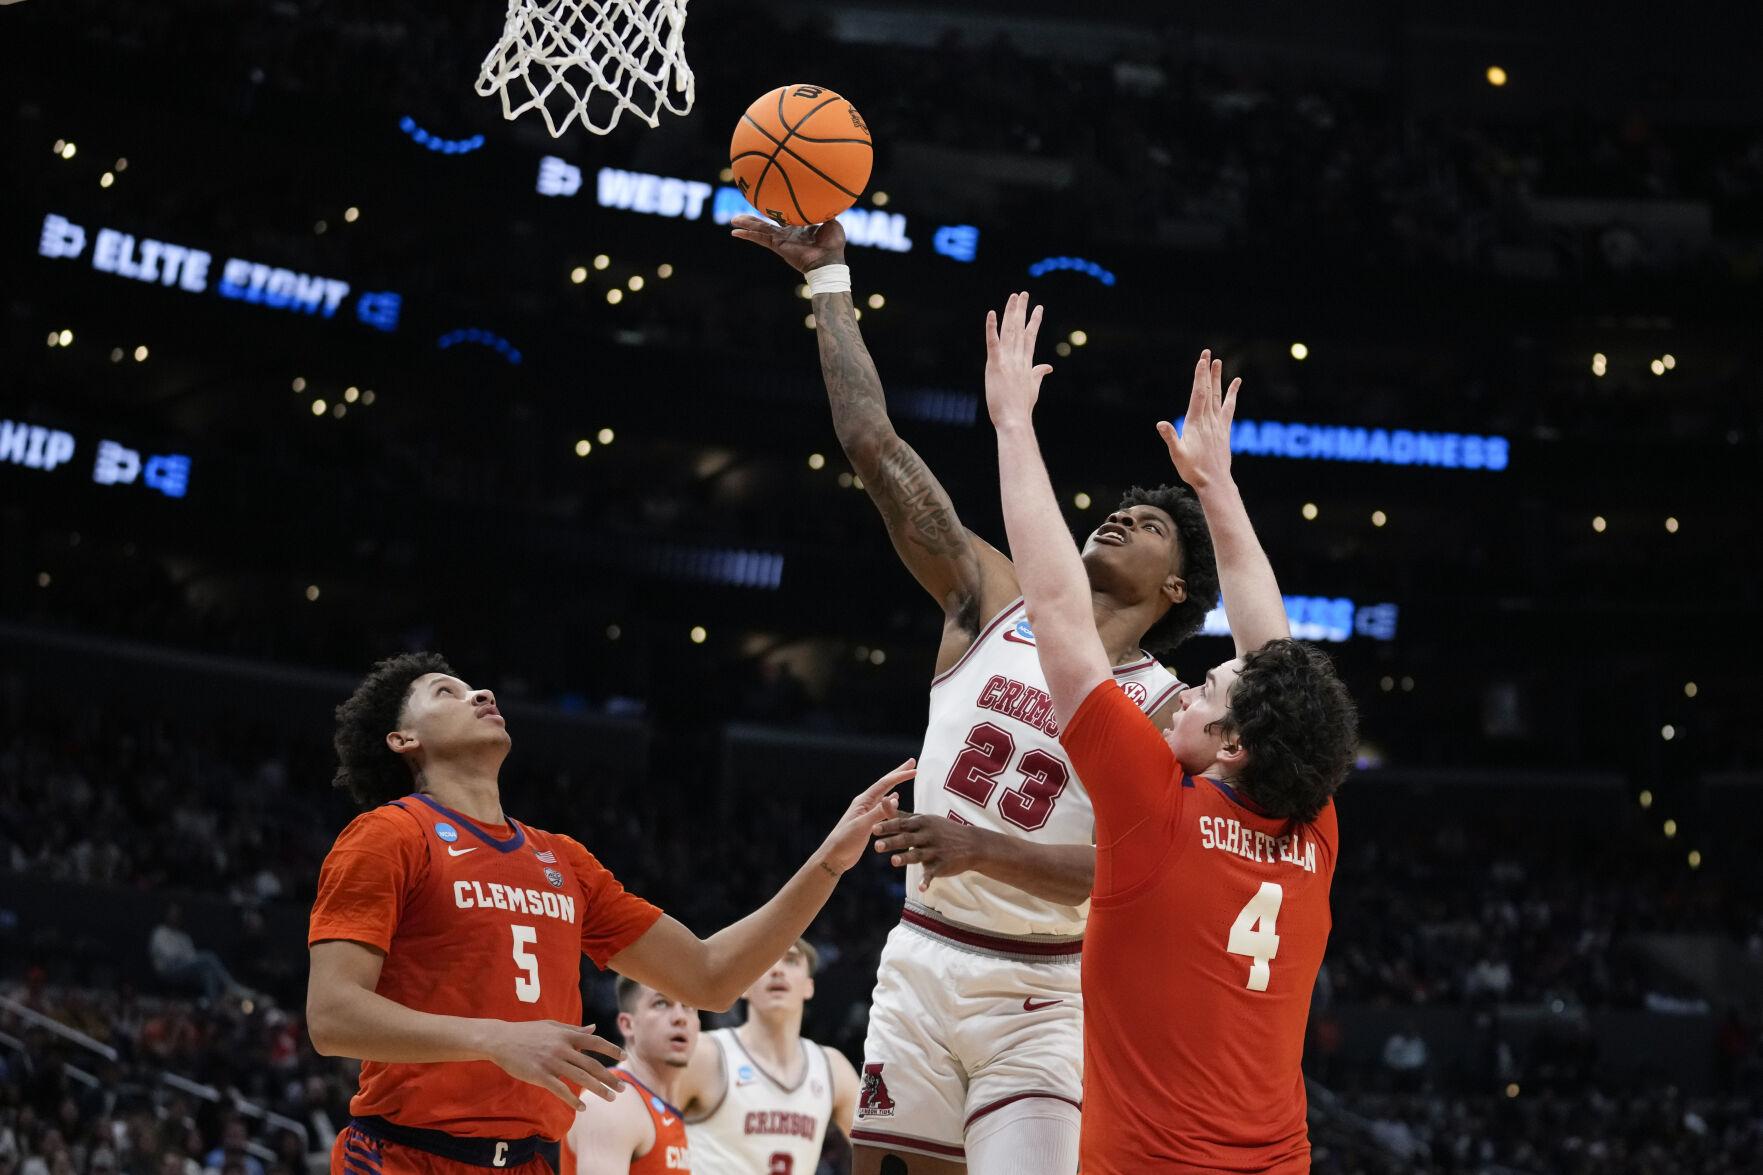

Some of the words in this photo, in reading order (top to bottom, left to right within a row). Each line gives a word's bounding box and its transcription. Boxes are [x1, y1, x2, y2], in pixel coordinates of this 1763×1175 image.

[598, 167, 712, 220] WEST
[92, 227, 211, 293] ELITE
[218, 257, 350, 319] EIGHT
[1175, 416, 1509, 471] ARCHMADNESS
[976, 674, 1061, 738] CRIMS
[943, 721, 1070, 832] 23
[453, 880, 576, 924] CLEMSON
[511, 924, 541, 1003] 5
[1227, 881, 1283, 992] 4
[492, 1141, 508, 1167] C
